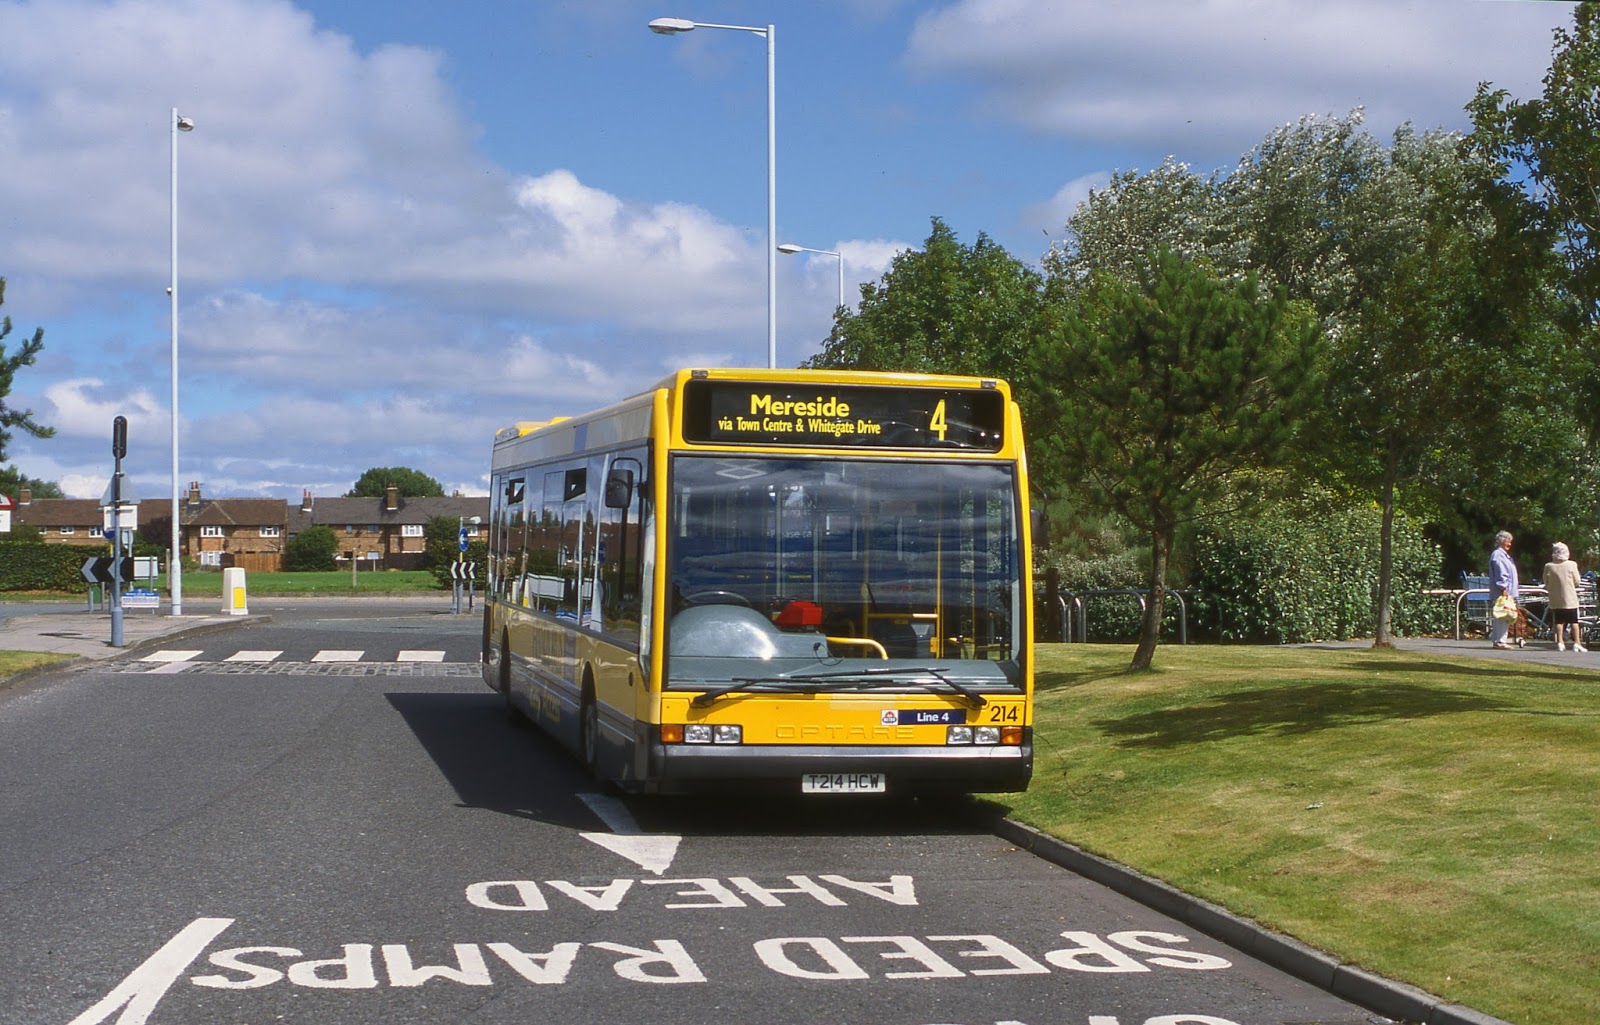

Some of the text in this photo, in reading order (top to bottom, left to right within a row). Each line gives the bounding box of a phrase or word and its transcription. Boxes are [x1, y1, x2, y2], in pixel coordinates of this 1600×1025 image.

[750, 394, 850, 417] Mereside
[718, 416, 881, 437] via Town Centre & Whitegate Drive
[929, 399, 948, 441] 4
[917, 712, 949, 722] Line 4
[990, 705, 1018, 722] 214
[776, 724, 915, 740] OPTARE
[808, 774, 879, 789] T214 HCW
[465, 874, 919, 912] AHEAD
[192, 930, 1233, 990] SPEED RAMPS
